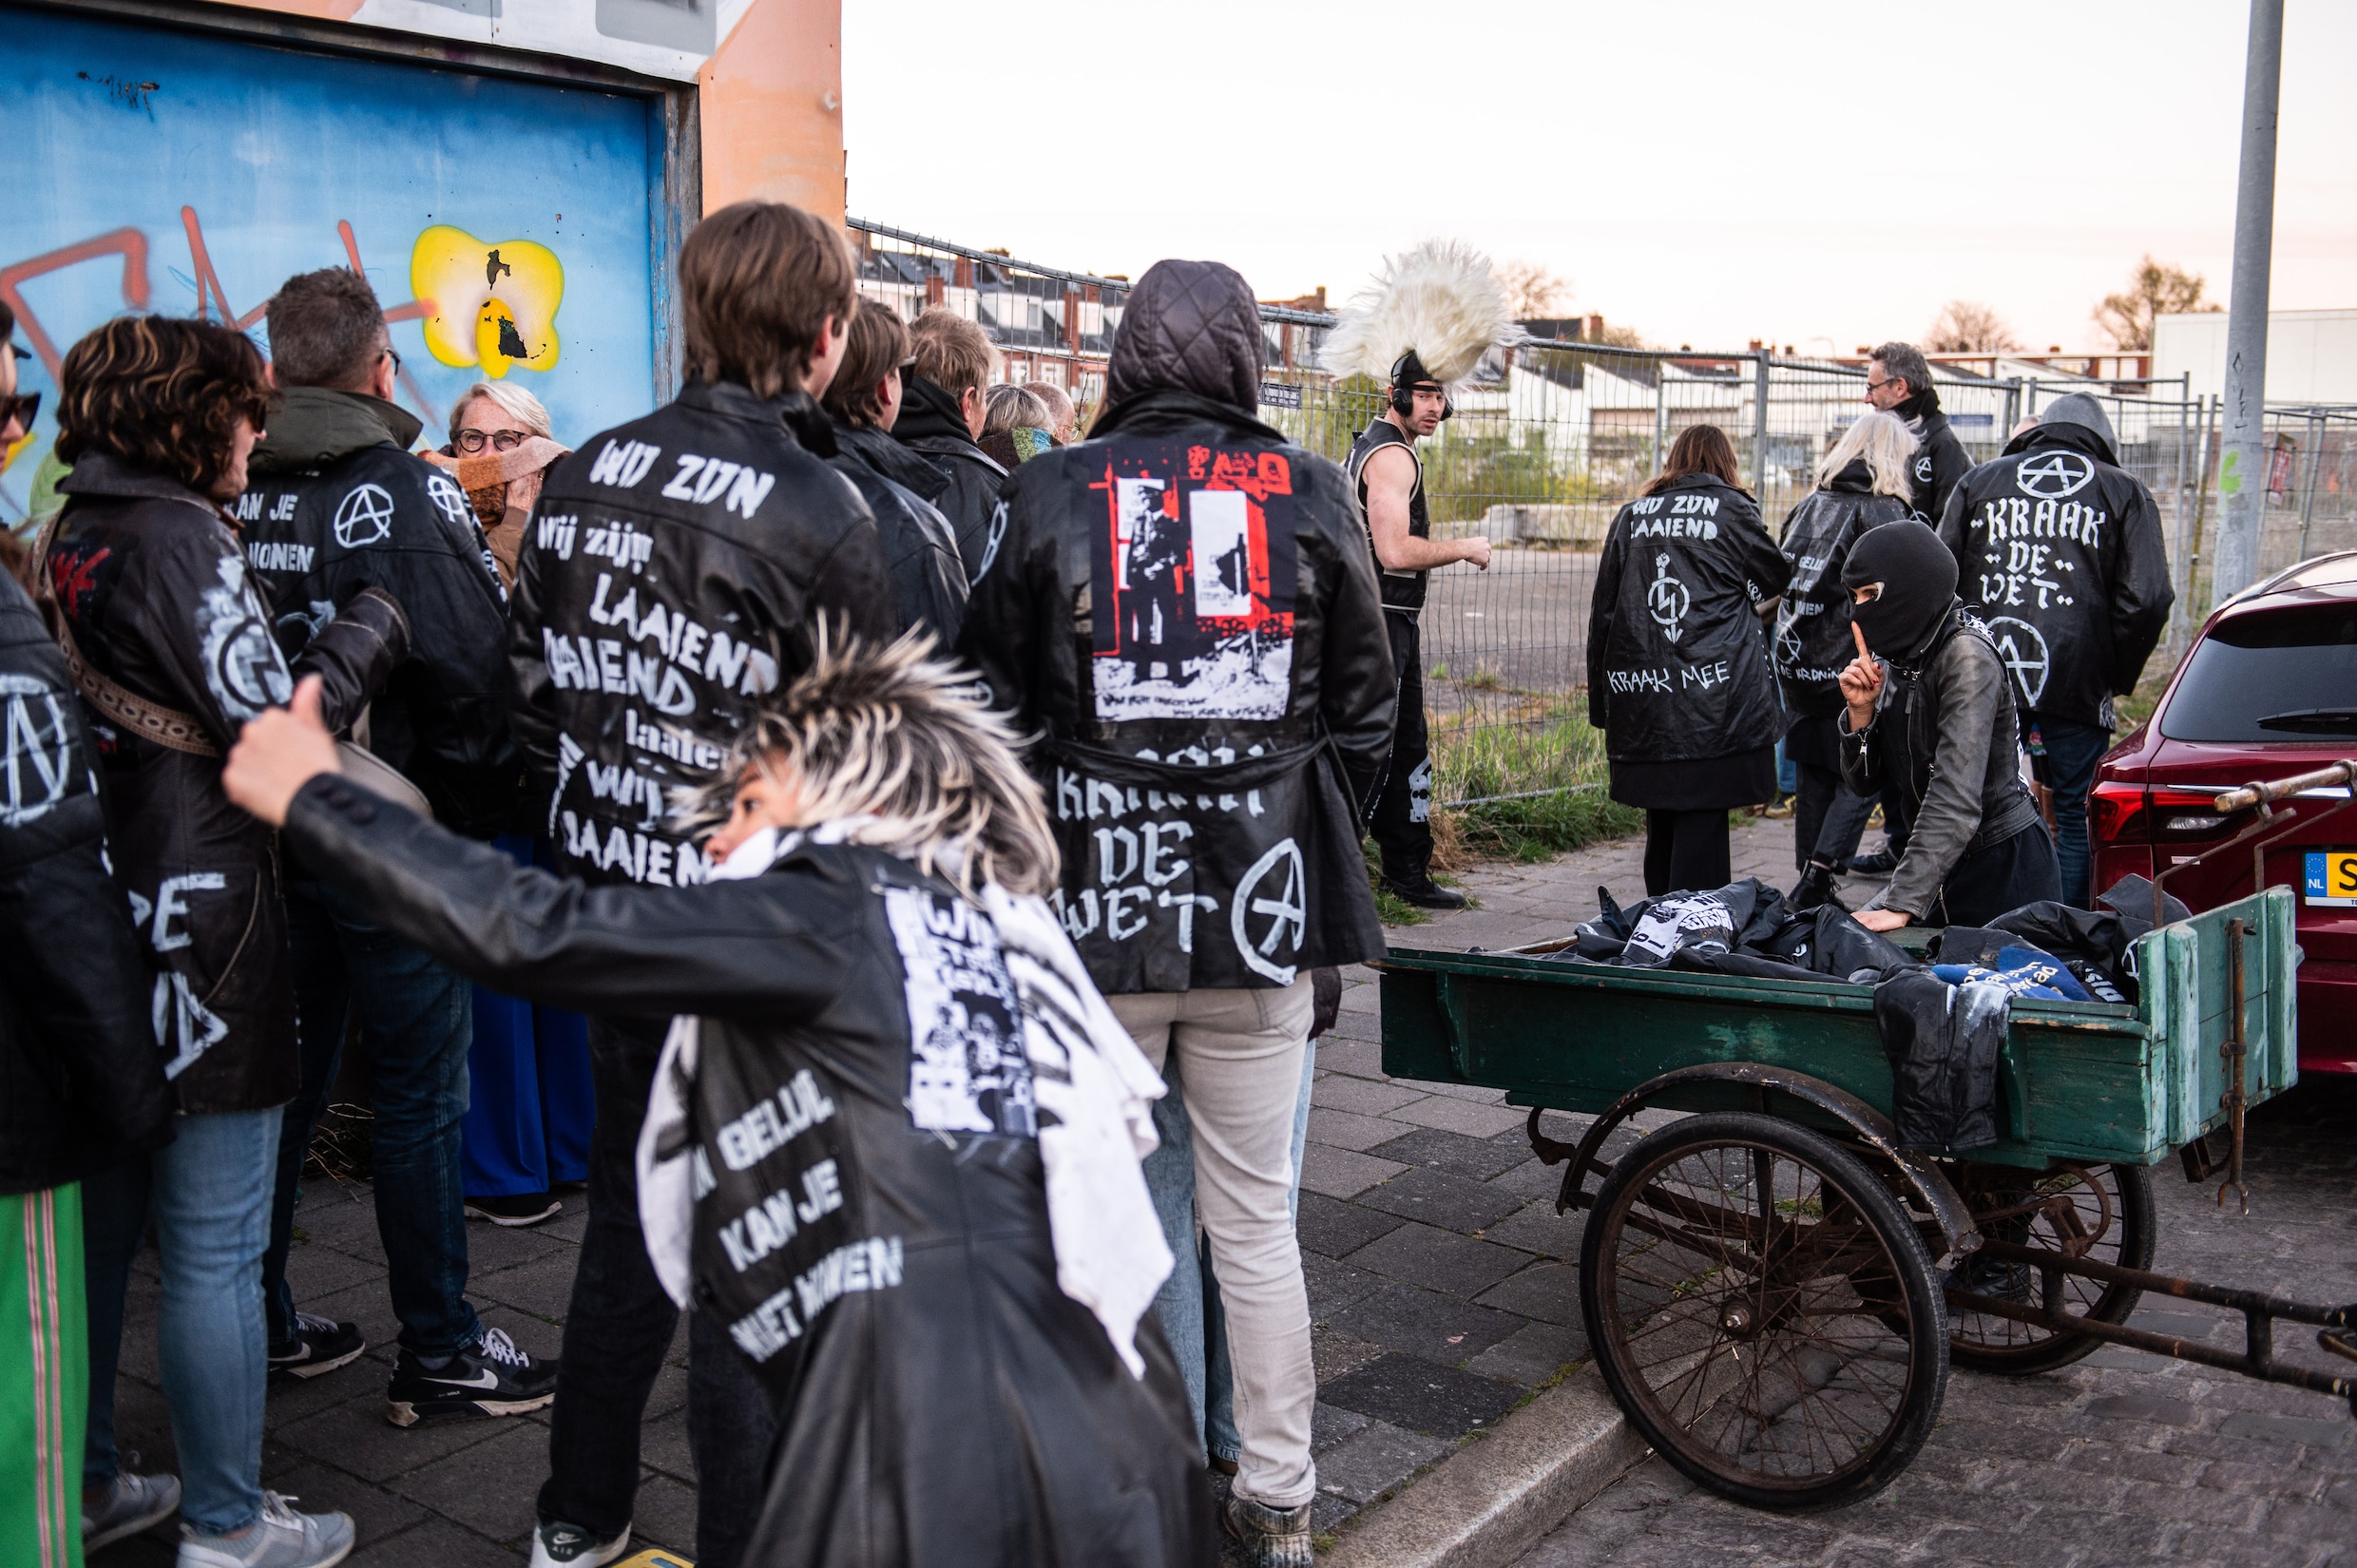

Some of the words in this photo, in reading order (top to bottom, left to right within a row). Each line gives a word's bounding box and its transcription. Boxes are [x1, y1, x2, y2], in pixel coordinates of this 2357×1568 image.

[269, 494, 298, 521] JE
[1985, 497, 2106, 548] KRAAK
[2006, 540, 2051, 577] DE
[1980, 573, 2061, 609] WET
[1607, 667, 1673, 694] KRAAK
[1680, 660, 1731, 690] MEE
[1093, 820, 1194, 887] DE
[2308, 878, 2325, 889] NL
[1048, 885, 1219, 955] WET
[719, 1188, 798, 1273] KAN
[796, 1157, 844, 1224] JE
